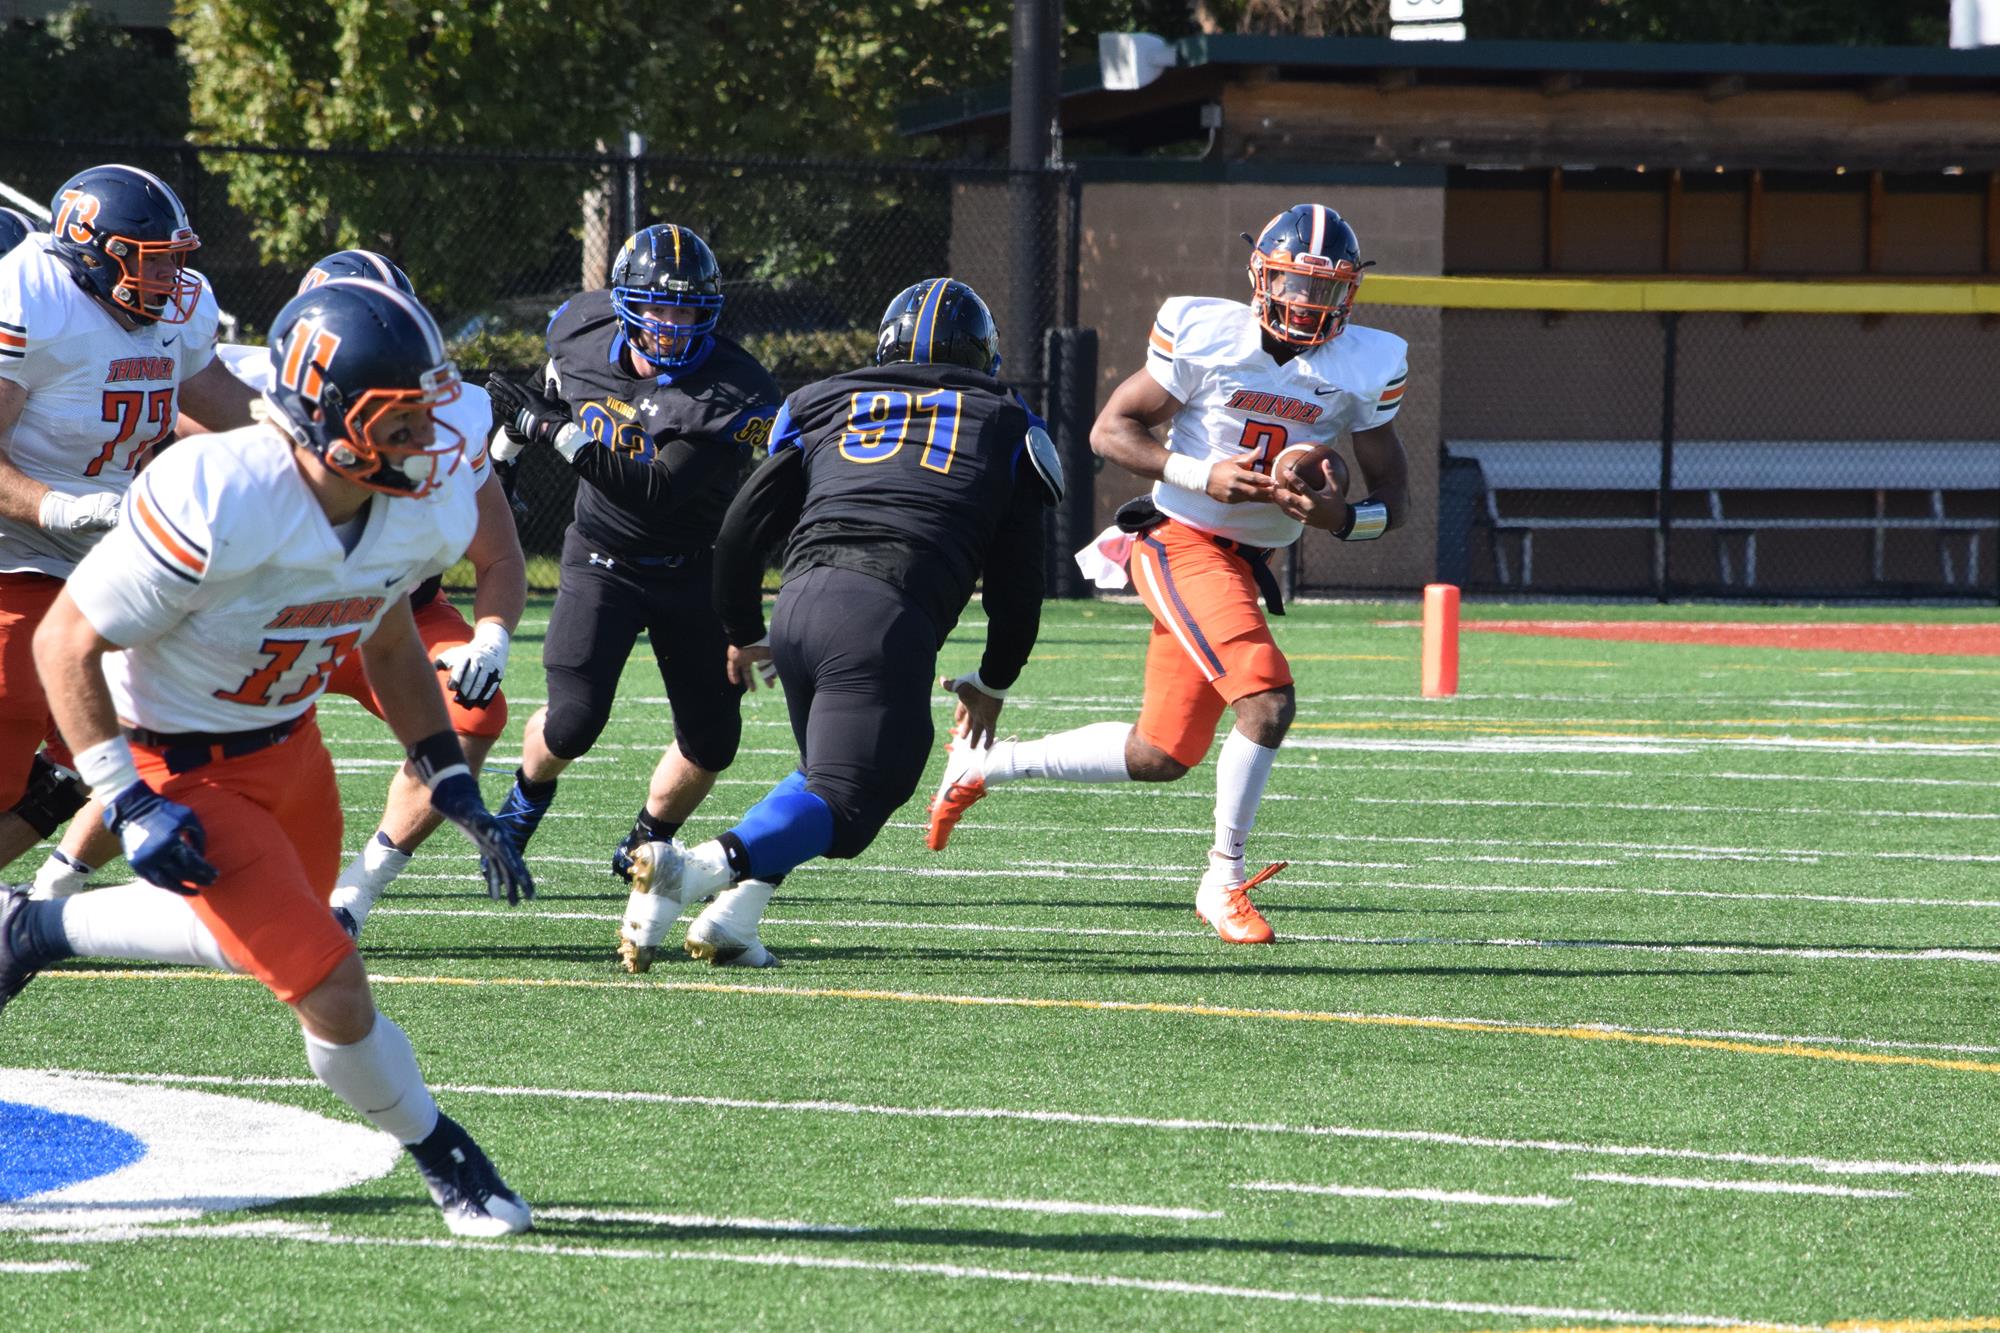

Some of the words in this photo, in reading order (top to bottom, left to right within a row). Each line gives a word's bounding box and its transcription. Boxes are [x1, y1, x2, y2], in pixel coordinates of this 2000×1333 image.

[54, 189, 101, 244] 73
[104, 356, 175, 384] THUNDER
[281, 315, 342, 404] 11
[606, 395, 637, 420] VIKINGS
[1224, 389, 1324, 425] THUNDER
[838, 388, 963, 475] 91
